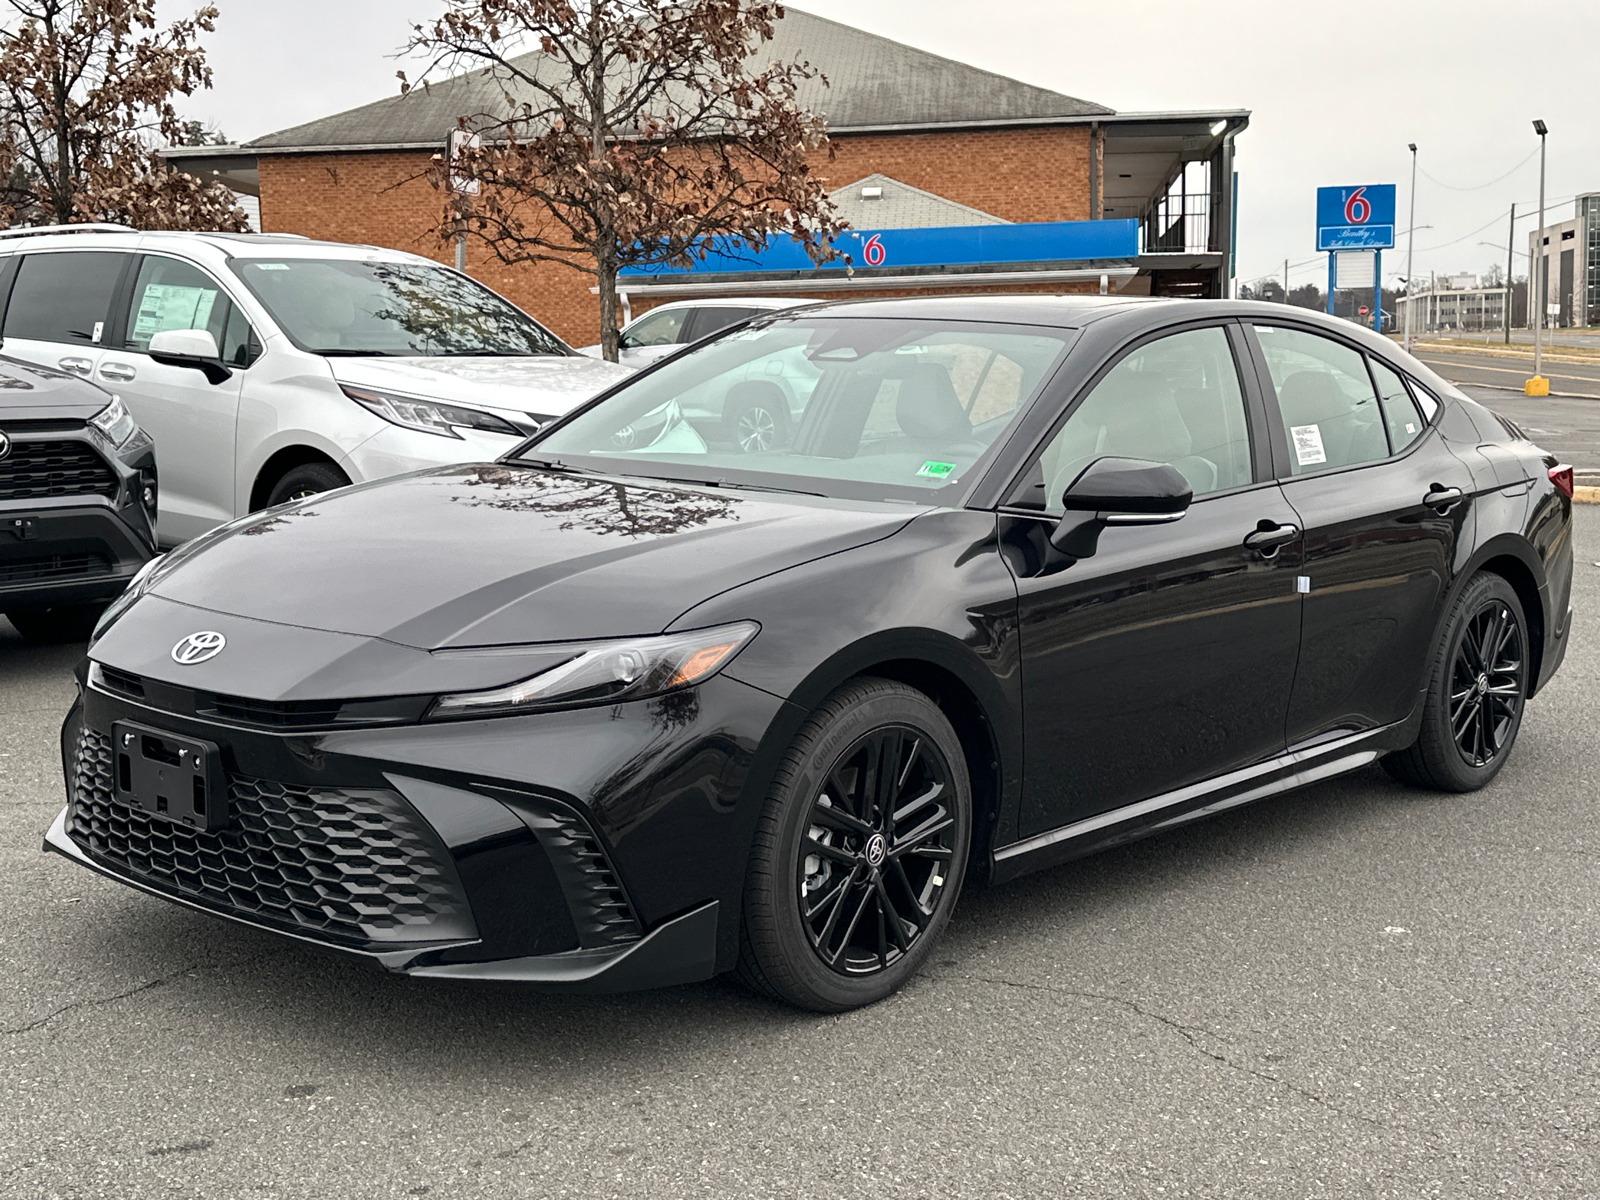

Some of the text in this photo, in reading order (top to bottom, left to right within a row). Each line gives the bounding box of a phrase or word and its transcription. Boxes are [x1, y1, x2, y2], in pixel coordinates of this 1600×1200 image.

[1344, 187, 1371, 224] 6
[863, 233, 886, 267] 6
[1337, 227, 1376, 239] Bentleys
